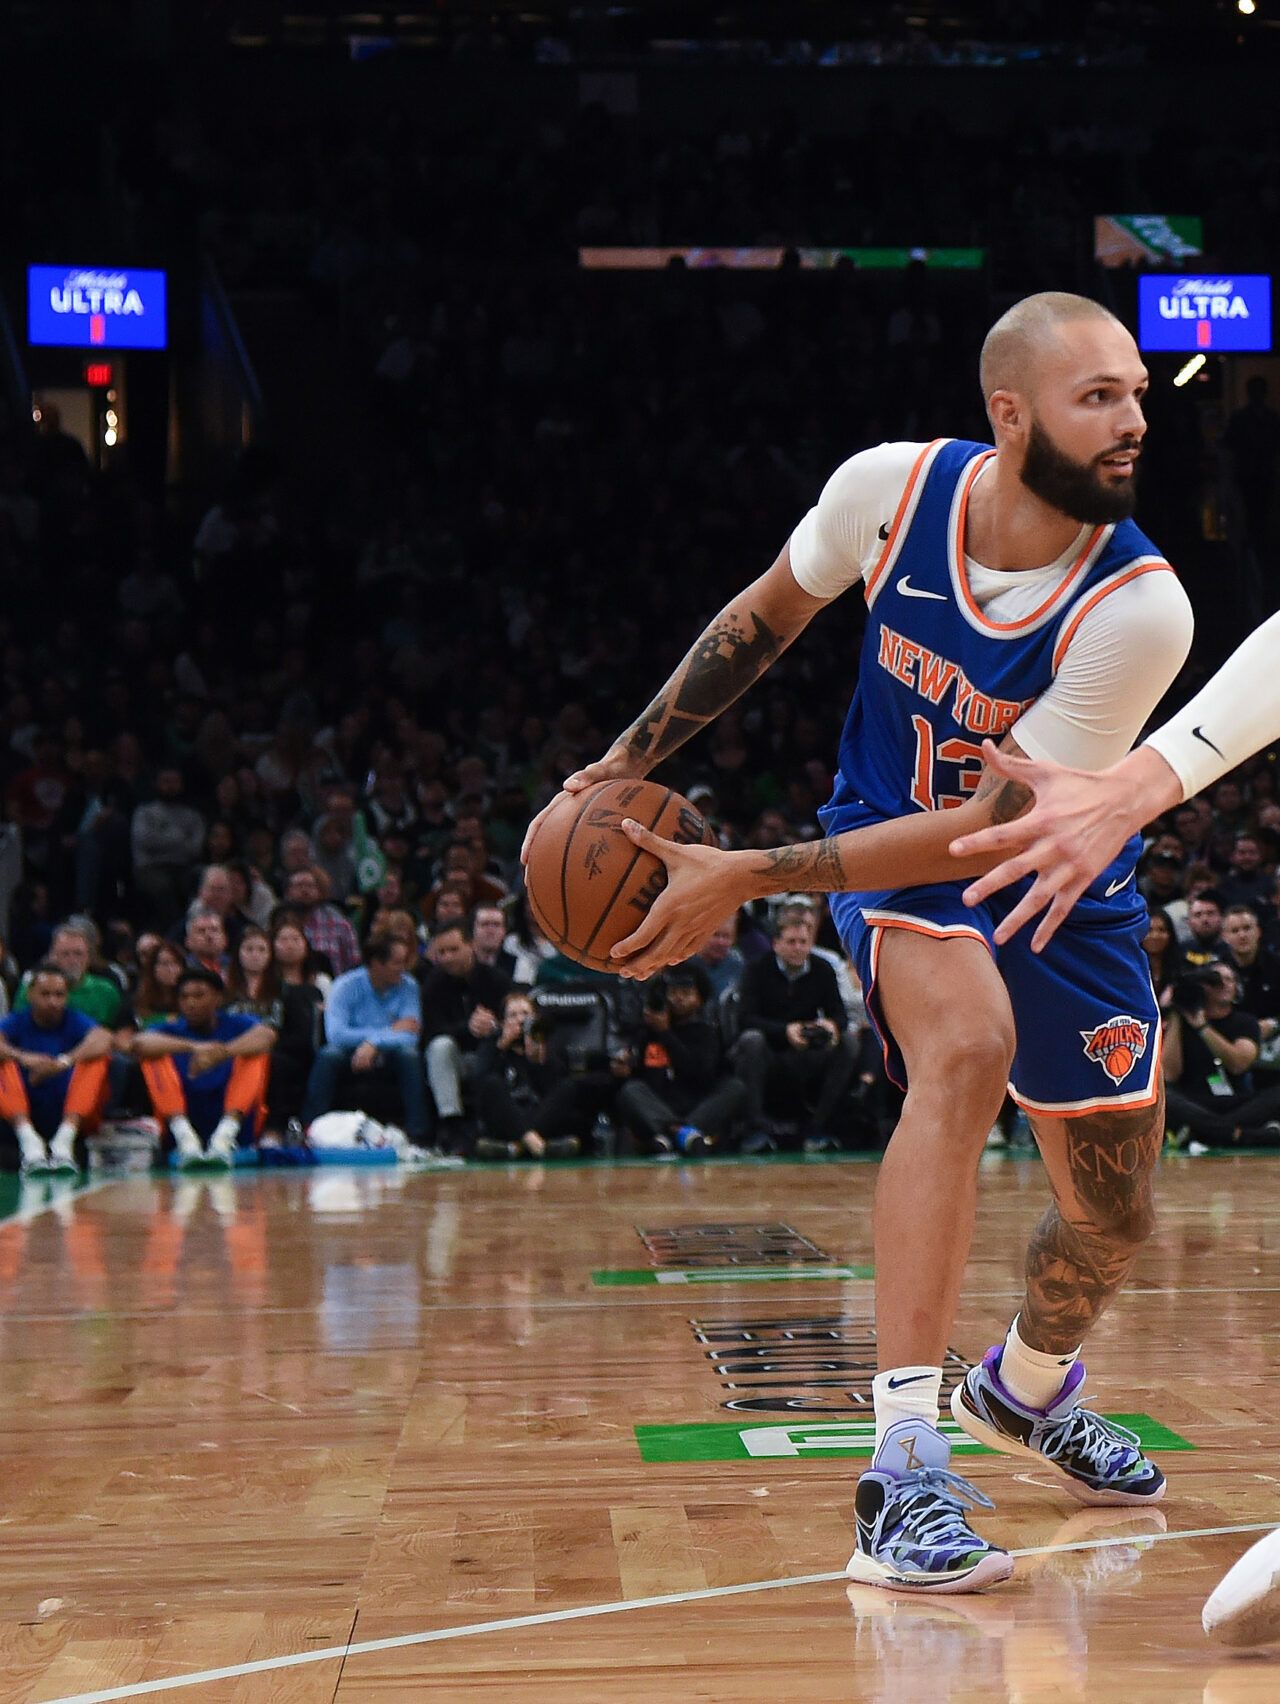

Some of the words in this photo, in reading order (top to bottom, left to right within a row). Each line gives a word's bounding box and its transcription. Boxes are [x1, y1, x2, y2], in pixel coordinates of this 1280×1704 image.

[50, 286, 145, 316] ULTRA
[1158, 295, 1250, 319] ULTRA
[877, 622, 959, 707] NEW
[951, 664, 1036, 736] YOR
[910, 713, 986, 813] 13
[1087, 1022, 1145, 1053] KNICKS
